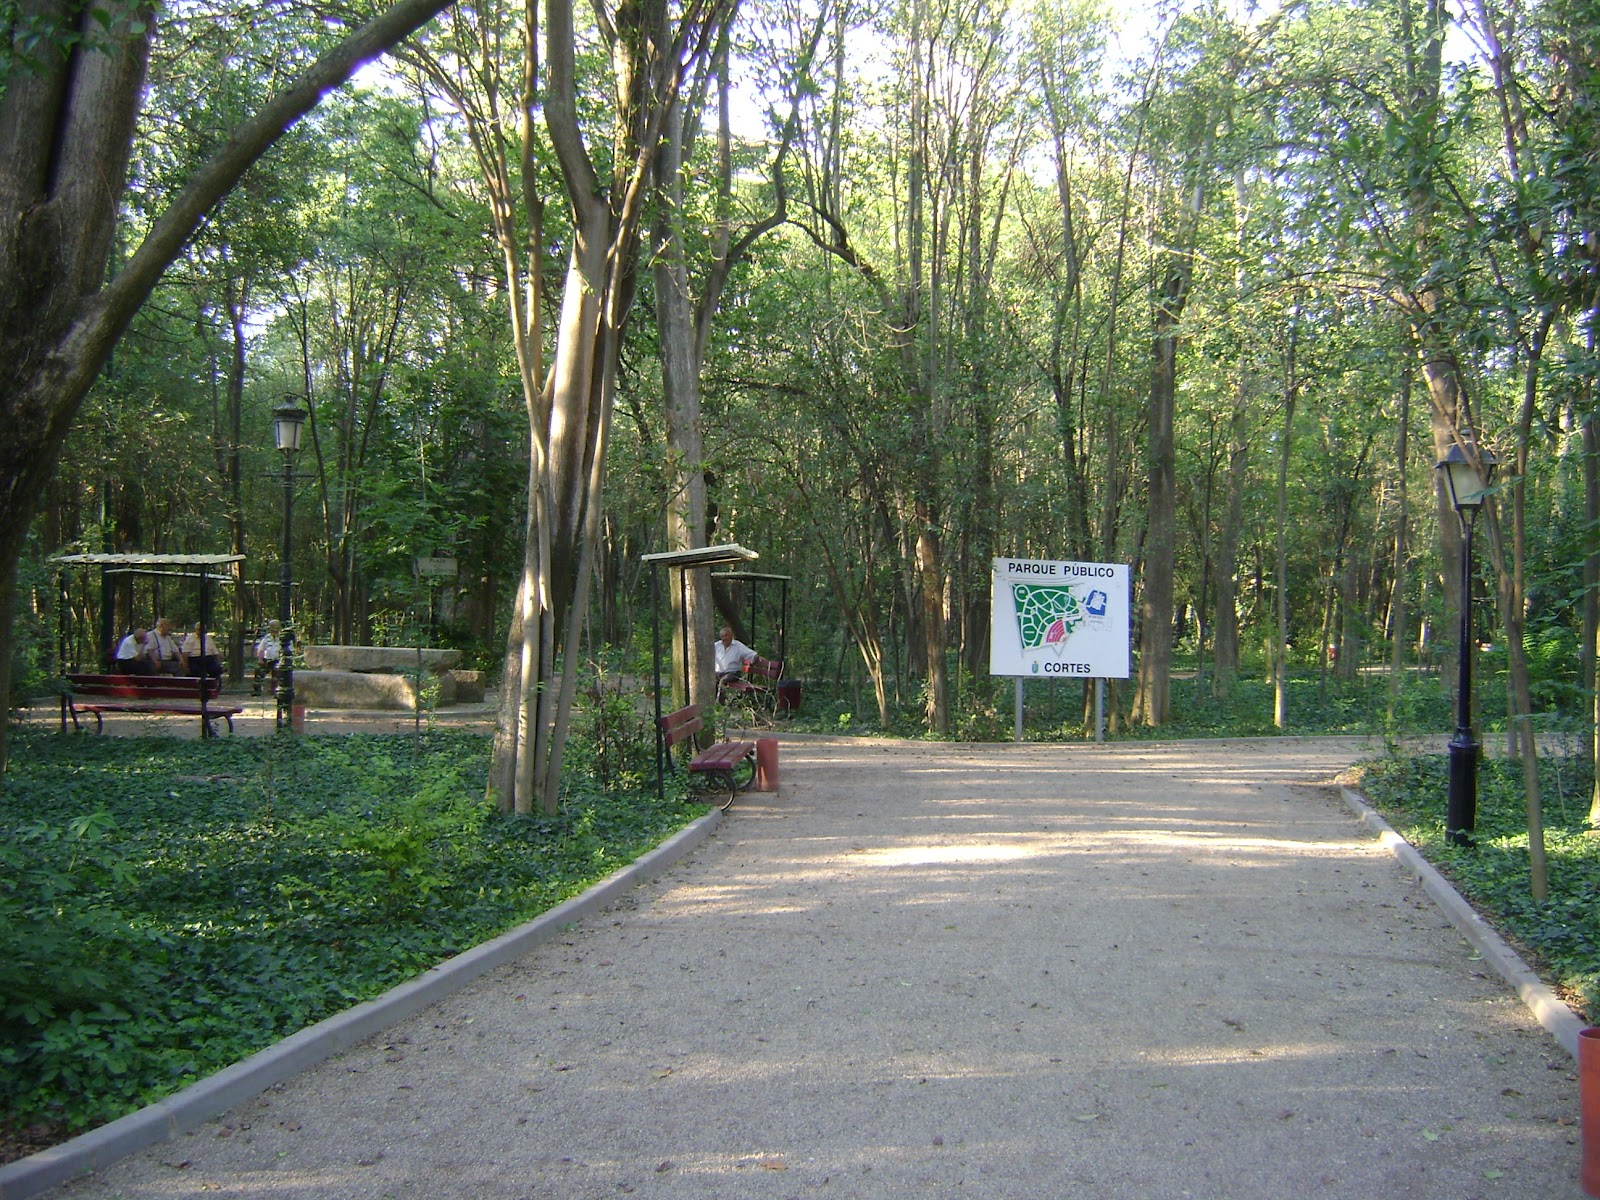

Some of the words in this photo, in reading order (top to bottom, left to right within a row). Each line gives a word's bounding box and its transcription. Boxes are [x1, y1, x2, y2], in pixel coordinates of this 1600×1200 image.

[1008, 562, 1056, 575] PARQUE
[1064, 563, 1115, 578] PÚBLICO
[1044, 662, 1091, 674] CORTES
